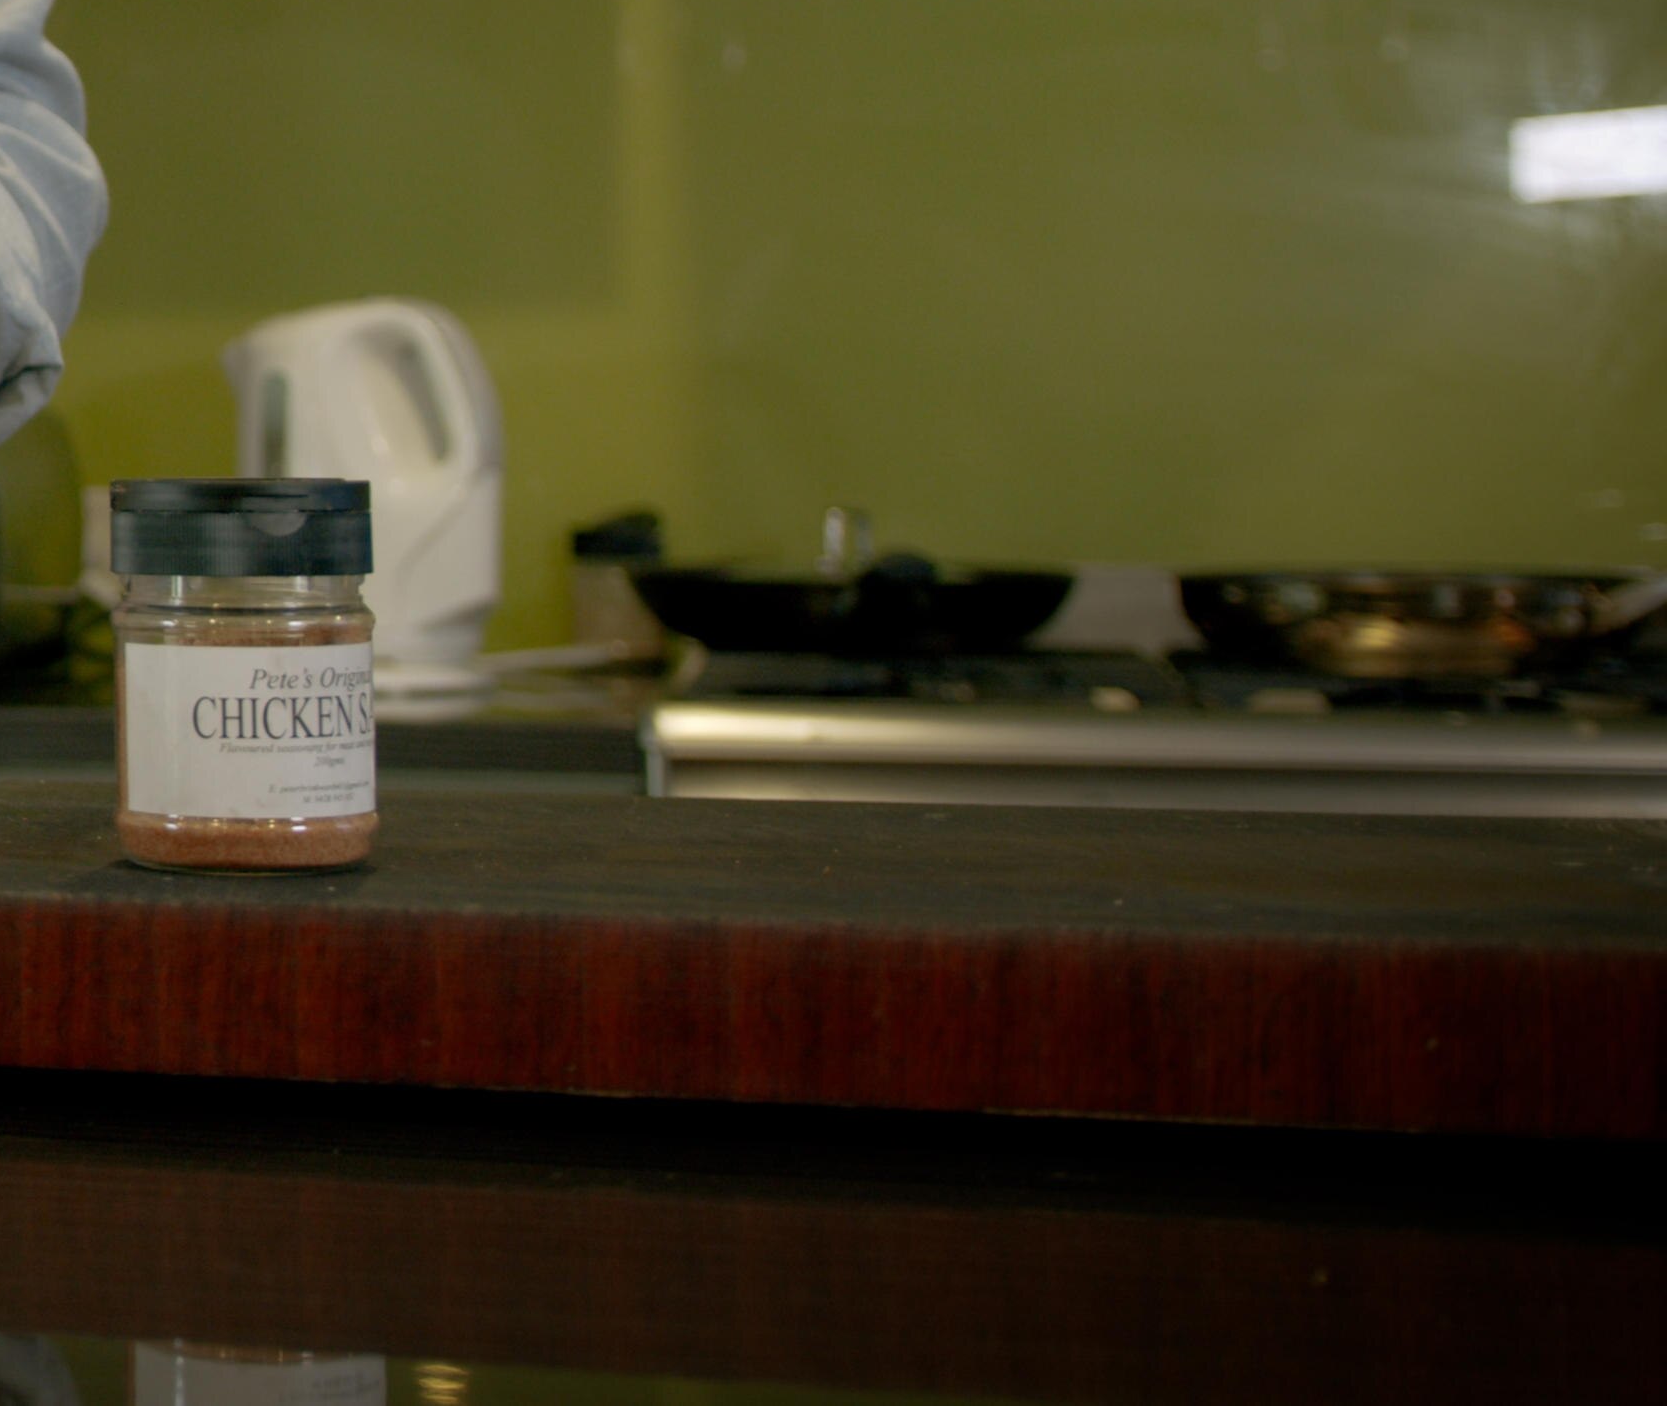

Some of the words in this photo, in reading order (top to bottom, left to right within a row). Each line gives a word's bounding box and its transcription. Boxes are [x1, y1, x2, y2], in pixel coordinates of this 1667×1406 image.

[250, 667, 314, 690] Pete's
[192, 695, 354, 740] CHICKEN
[219, 743, 274, 754] Flavoured
